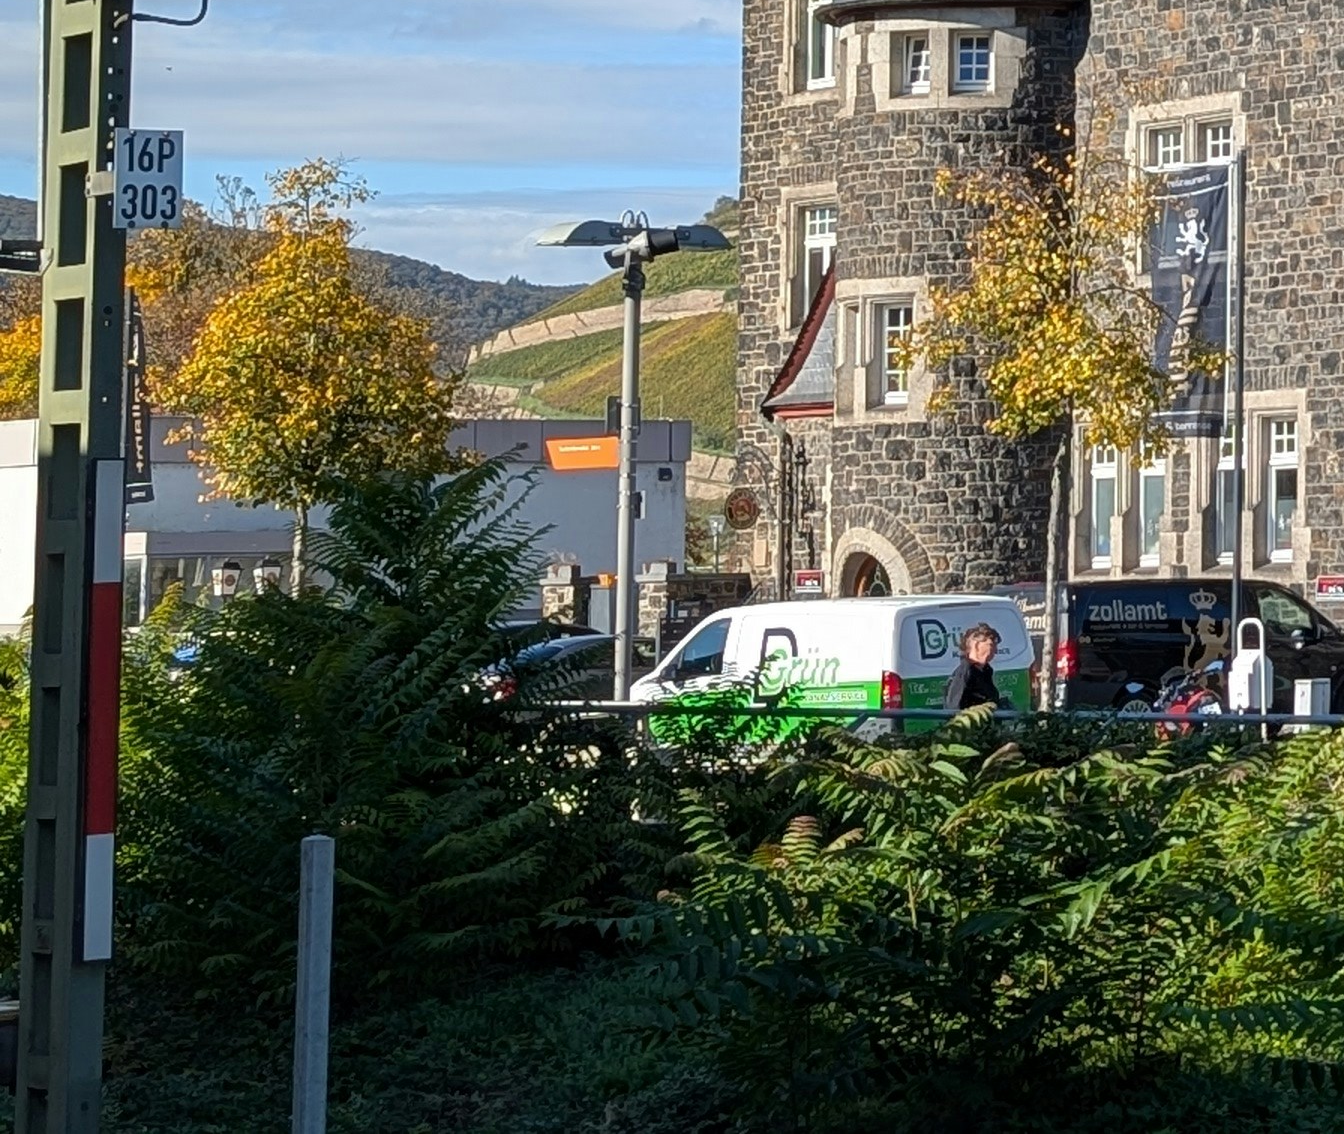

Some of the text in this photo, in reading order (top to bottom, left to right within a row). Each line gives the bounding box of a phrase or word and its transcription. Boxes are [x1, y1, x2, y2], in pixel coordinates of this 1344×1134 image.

[123, 137, 175, 173] 16P
[121, 184, 177, 220] 303
[1089, 599, 1168, 622] zollamt
